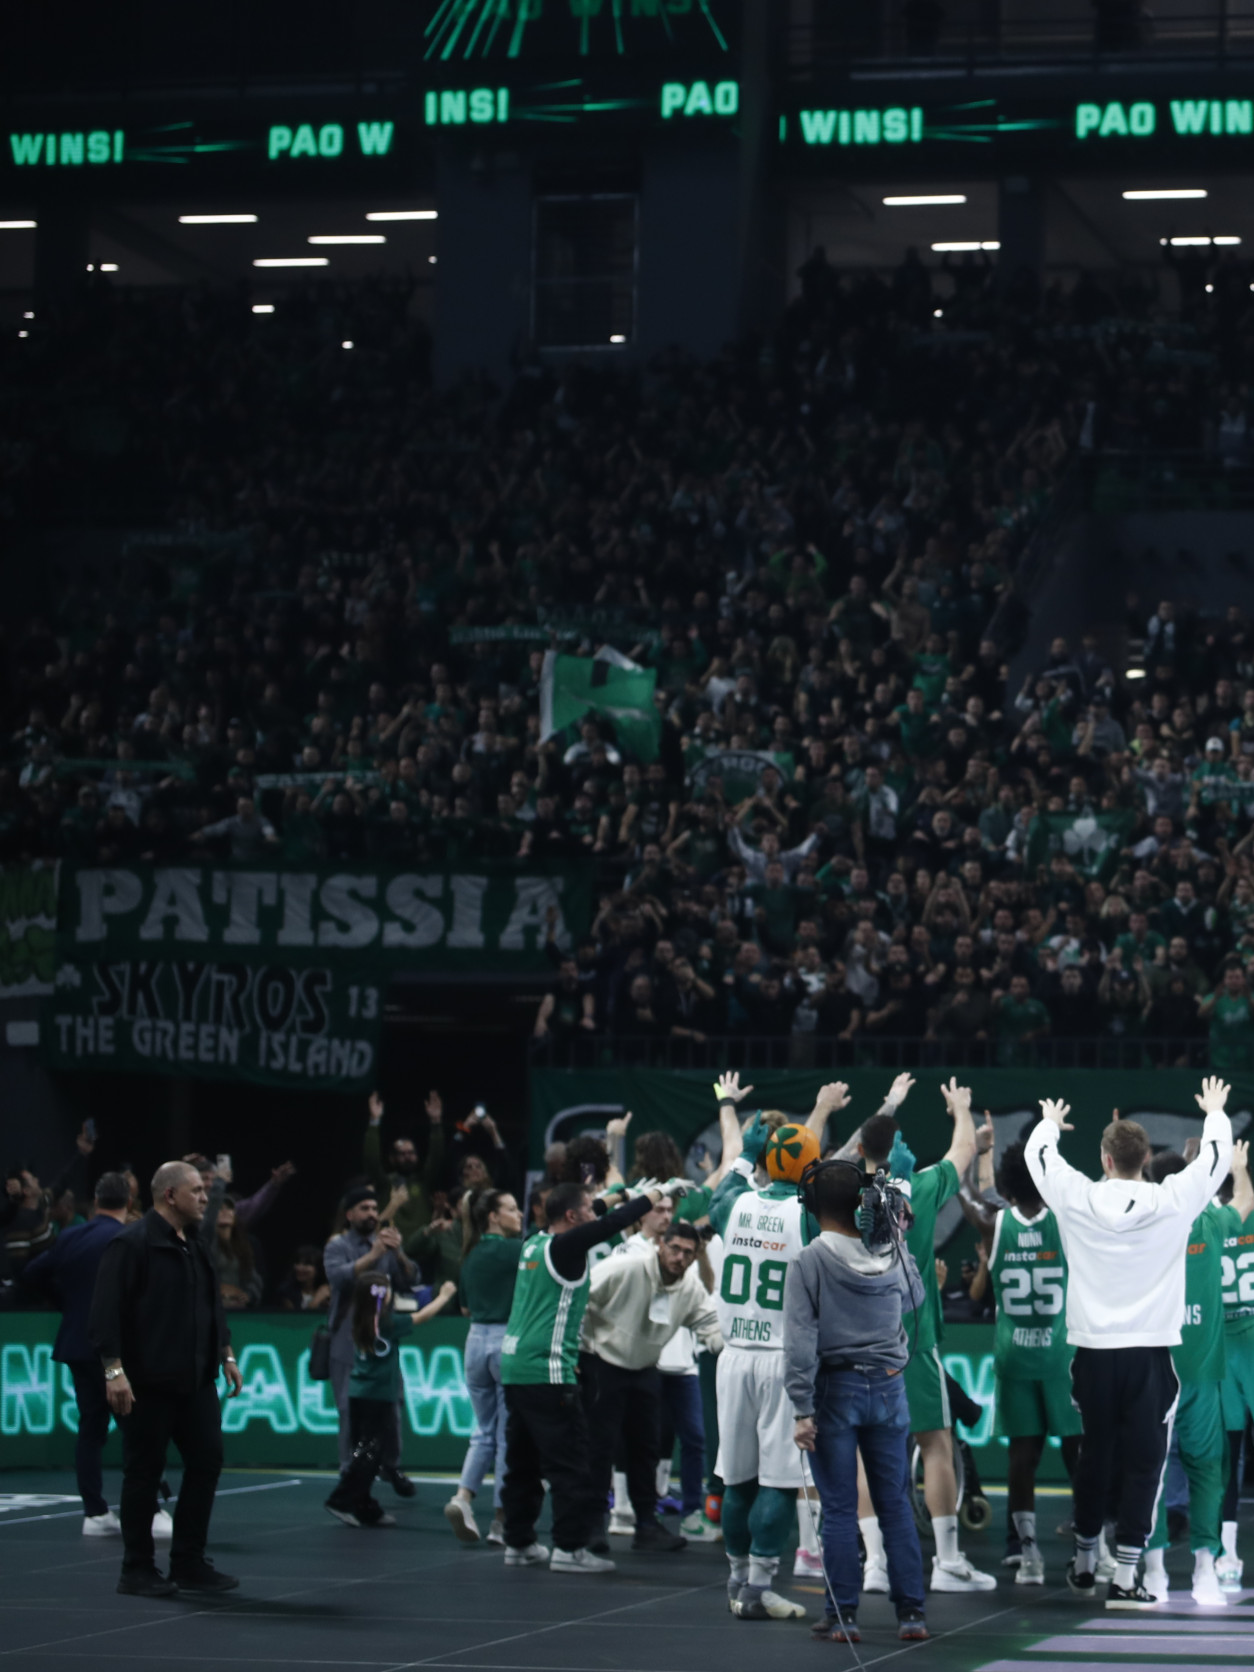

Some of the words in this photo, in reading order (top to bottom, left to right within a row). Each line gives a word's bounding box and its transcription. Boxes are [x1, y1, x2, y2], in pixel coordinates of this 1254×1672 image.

[661, 80, 739, 120] PAO
[268, 123, 344, 159] PAO
[800, 107, 923, 144] WINS!
[1076, 102, 1156, 139] PAO
[75, 867, 573, 950] PATISSIA
[93, 961, 333, 1036] SKYROS
[347, 985, 379, 1020] 13
[55, 1014, 115, 1058] THE
[132, 1021, 240, 1065] GREEN
[258, 1032, 375, 1078] ISLAND
[732, 1234, 787, 1251] instacar
[757, 1215, 785, 1233] GREEN
[1017, 1231, 1043, 1248] NUNN
[1004, 1250, 1058, 1262] instacar
[720, 1254, 788, 1311] 08
[999, 1267, 1064, 1315] 25
[730, 1317, 772, 1342] ATHENS
[1012, 1327, 1053, 1347] ATHENS
